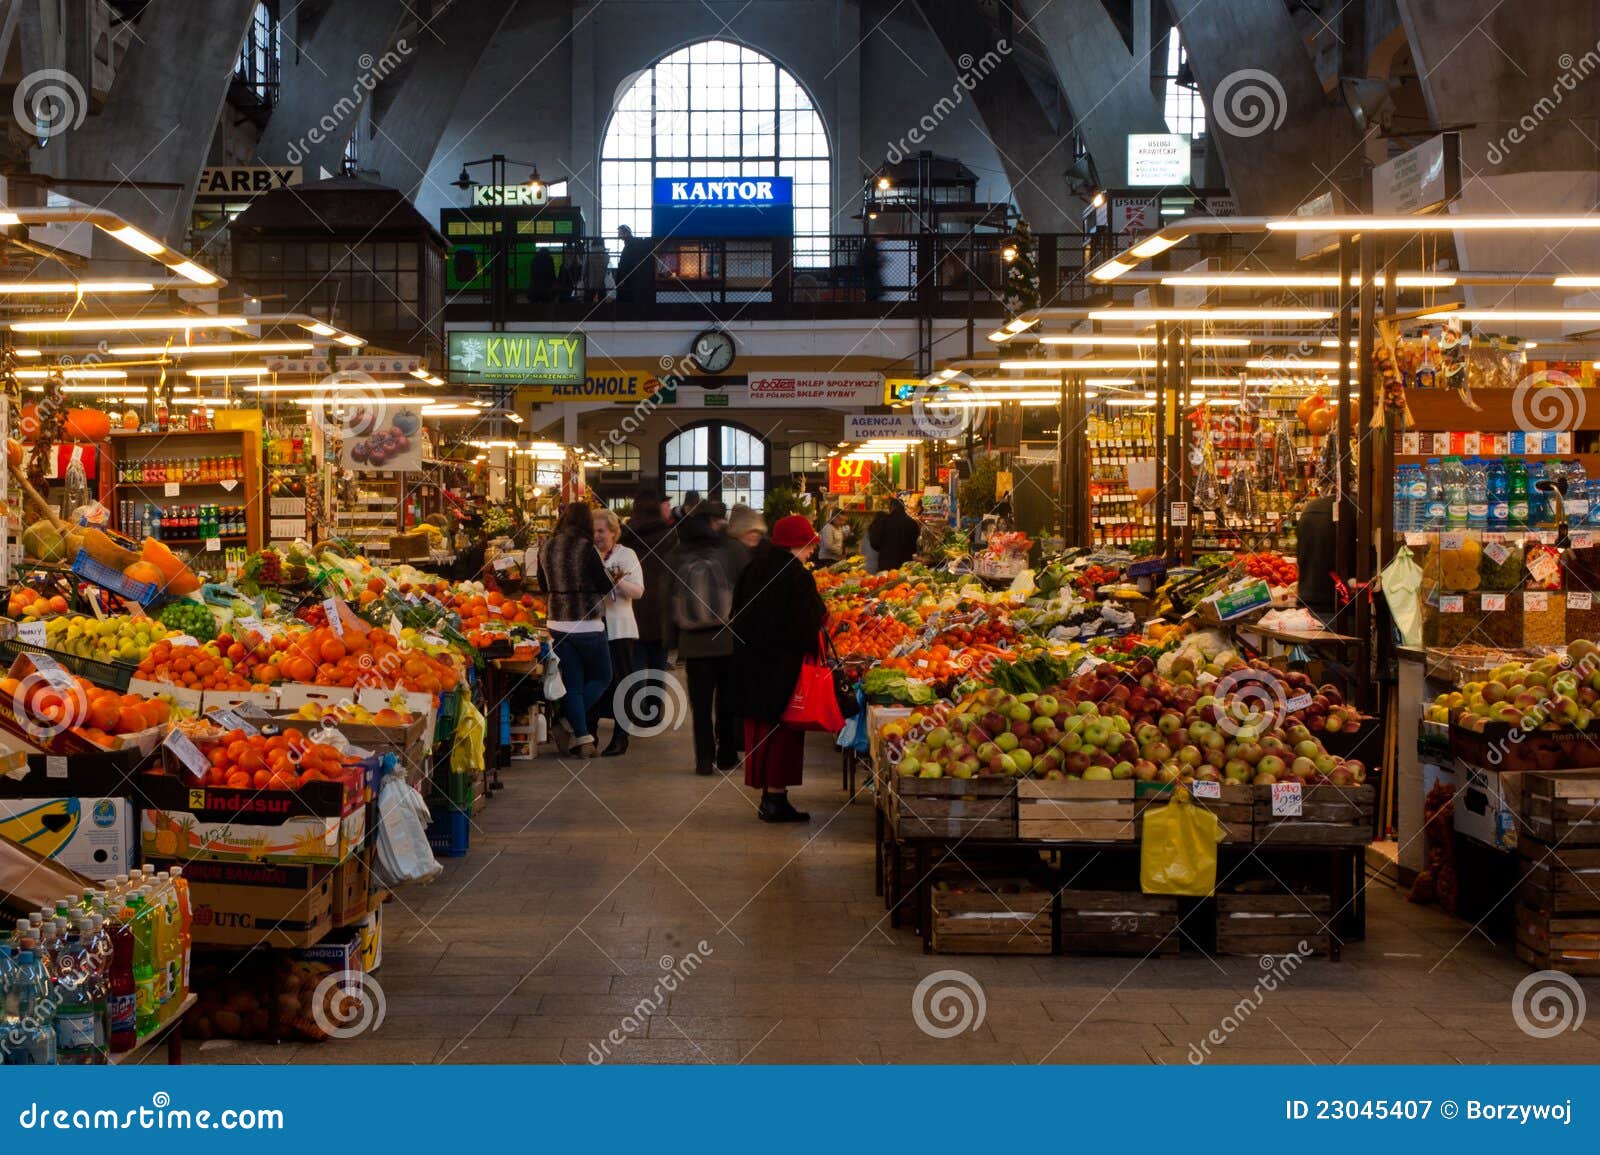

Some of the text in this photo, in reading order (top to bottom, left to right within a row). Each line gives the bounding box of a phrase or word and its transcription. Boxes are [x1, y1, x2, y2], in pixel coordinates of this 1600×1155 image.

[198, 170, 294, 192] FARBY
[473, 184, 548, 206] KSERO
[671, 182, 774, 200] KANTOR
[486, 338, 580, 369] KWIATY
[797, 380, 824, 388] SKLEP
[797, 390, 824, 398] SKLEP
[851, 417, 902, 426] AGENCJA
[855, 429, 898, 438] LOKATY
[206, 793, 292, 813] indasur
